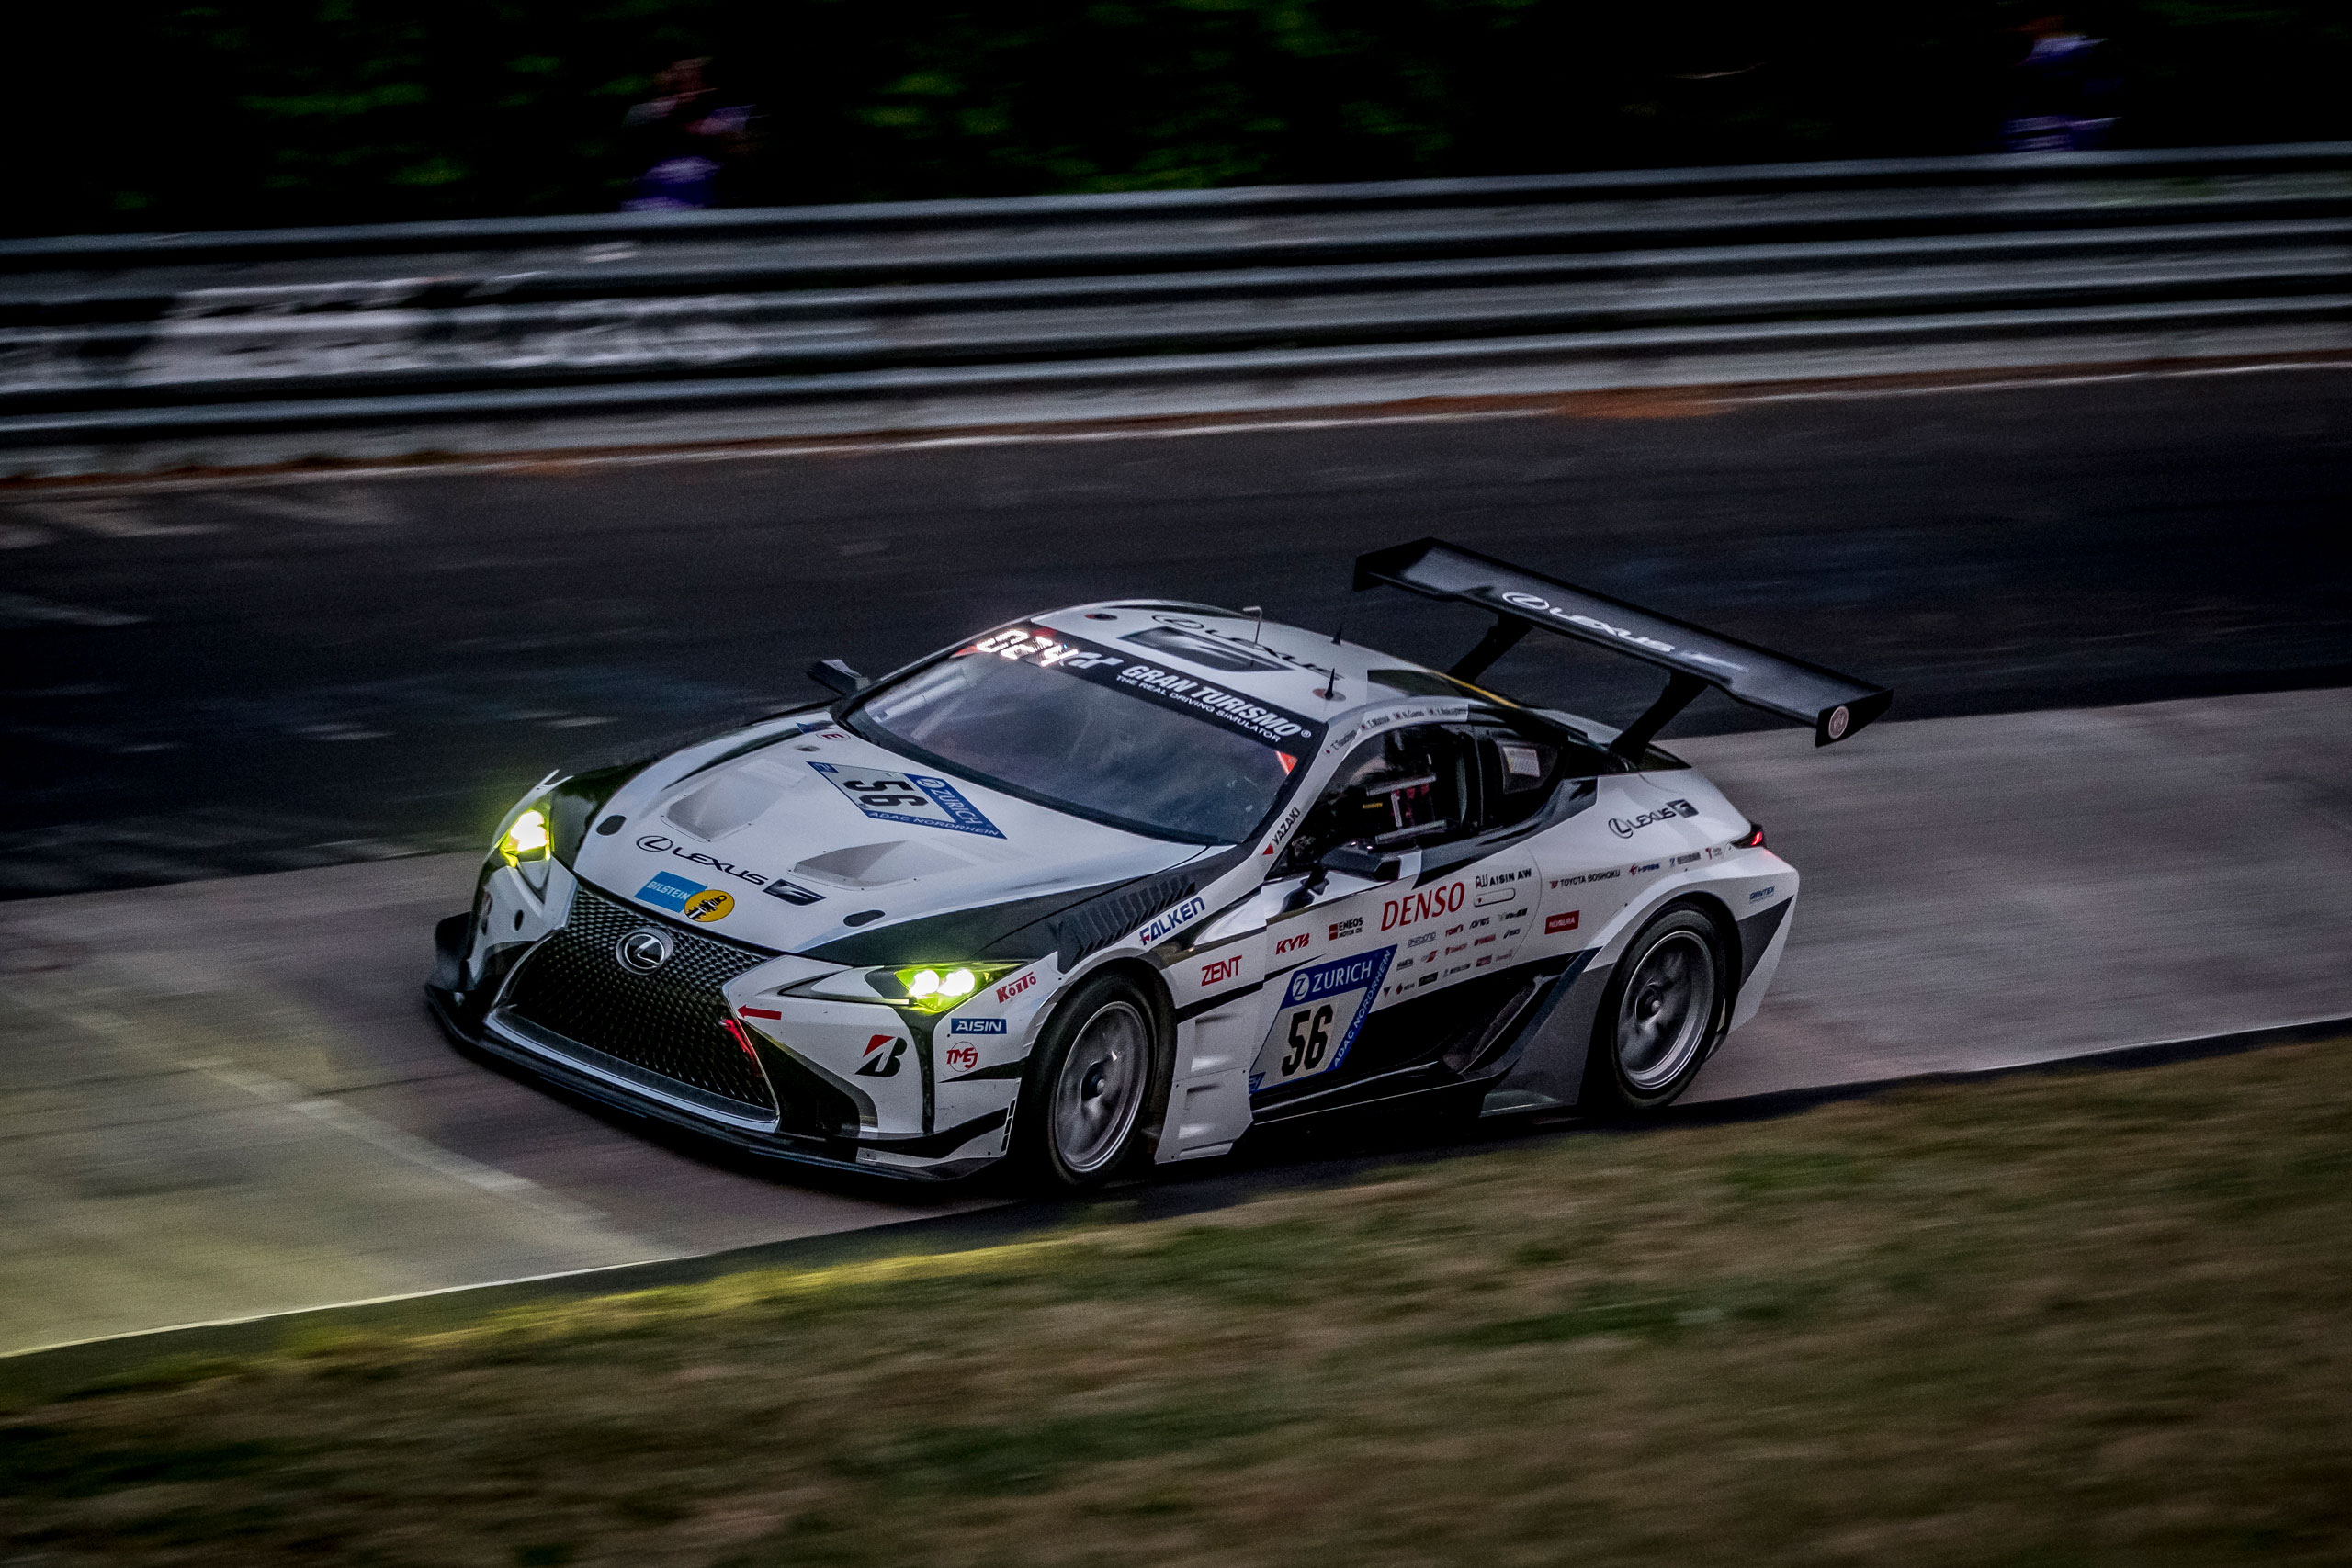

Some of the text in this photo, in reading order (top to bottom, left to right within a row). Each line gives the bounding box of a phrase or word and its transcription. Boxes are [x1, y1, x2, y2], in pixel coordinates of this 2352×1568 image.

[1122, 665, 1198, 693] GRAN
[1116, 674, 1282, 743] THE REAL DRIVING SIMULATOR
[842, 780, 929, 807] 56
[930, 788, 983, 825] ZURICH
[868, 812, 1000, 836] ADAC NORDRHEIN
[1272, 807, 1301, 846] YAZAKI
[1626, 807, 1677, 829] LEXUS
[672, 846, 769, 886] LEXUS
[1489, 872, 1515, 886] AISIN
[1517, 868, 1532, 881] AW
[1560, 869, 1621, 887] TOYOTA BOSHOKU
[646, 880, 692, 902] BILSTEIN
[1380, 882, 1465, 931] DENSO
[1140, 897, 1205, 947] FALKEN
[1339, 916, 1363, 931] ENEOS
[1275, 932, 1310, 955] KYB
[1201, 955, 1243, 987] ZENT
[1311, 959, 1373, 993] ZURICH
[1333, 949, 1392, 1068] ADAC NORDRHEIN
[956, 1021, 1002, 1032] AISIN
[1281, 1003, 1334, 1077] 56
